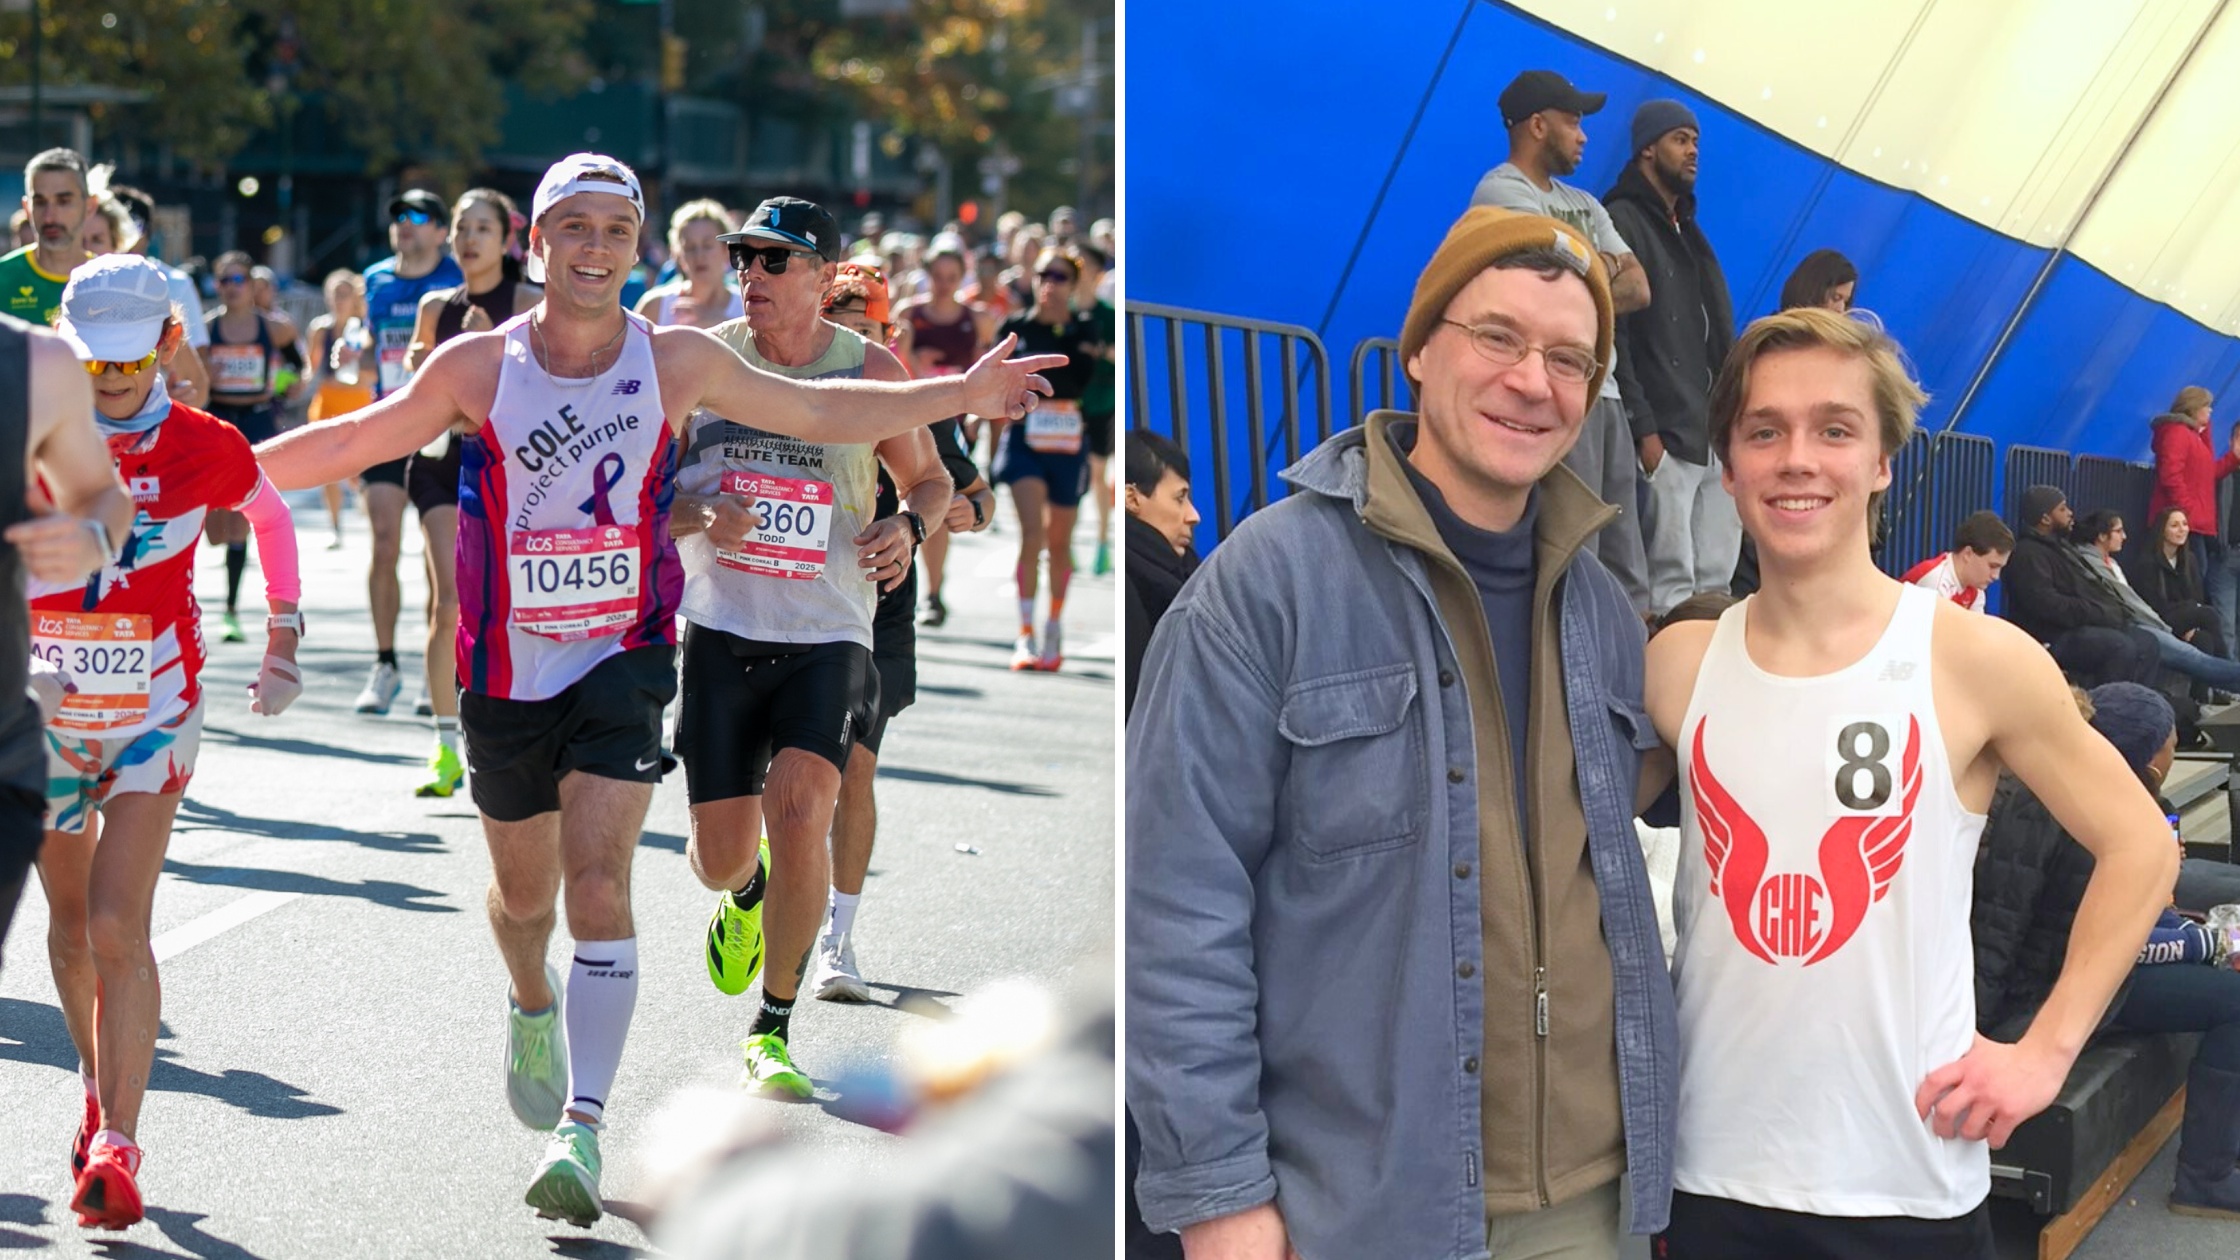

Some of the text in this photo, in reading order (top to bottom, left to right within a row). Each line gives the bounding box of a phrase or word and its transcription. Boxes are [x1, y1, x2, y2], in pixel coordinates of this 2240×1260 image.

[515, 403, 586, 472] COLE
[723, 447, 823, 468] ELITE TEAM
[515, 413, 639, 531] project purple
[760, 483, 794, 493] CONSULTANCY
[134, 494, 159, 503] JAPAN
[801, 493, 819, 501] TATA
[555, 538, 594, 546] CONSULTANCY
[757, 532, 786, 544] TODD
[603, 539, 624, 548] TATA
[751, 557, 772, 566] CORRAL
[794, 562, 816, 571] 2025
[520, 553, 630, 593] 10456
[66, 617, 81, 625] TATA
[113, 630, 135, 638] TATA
[74, 647, 145, 674] 3022
[1834, 721, 1893, 811] 8
[1760, 873, 1824, 957] CHE
